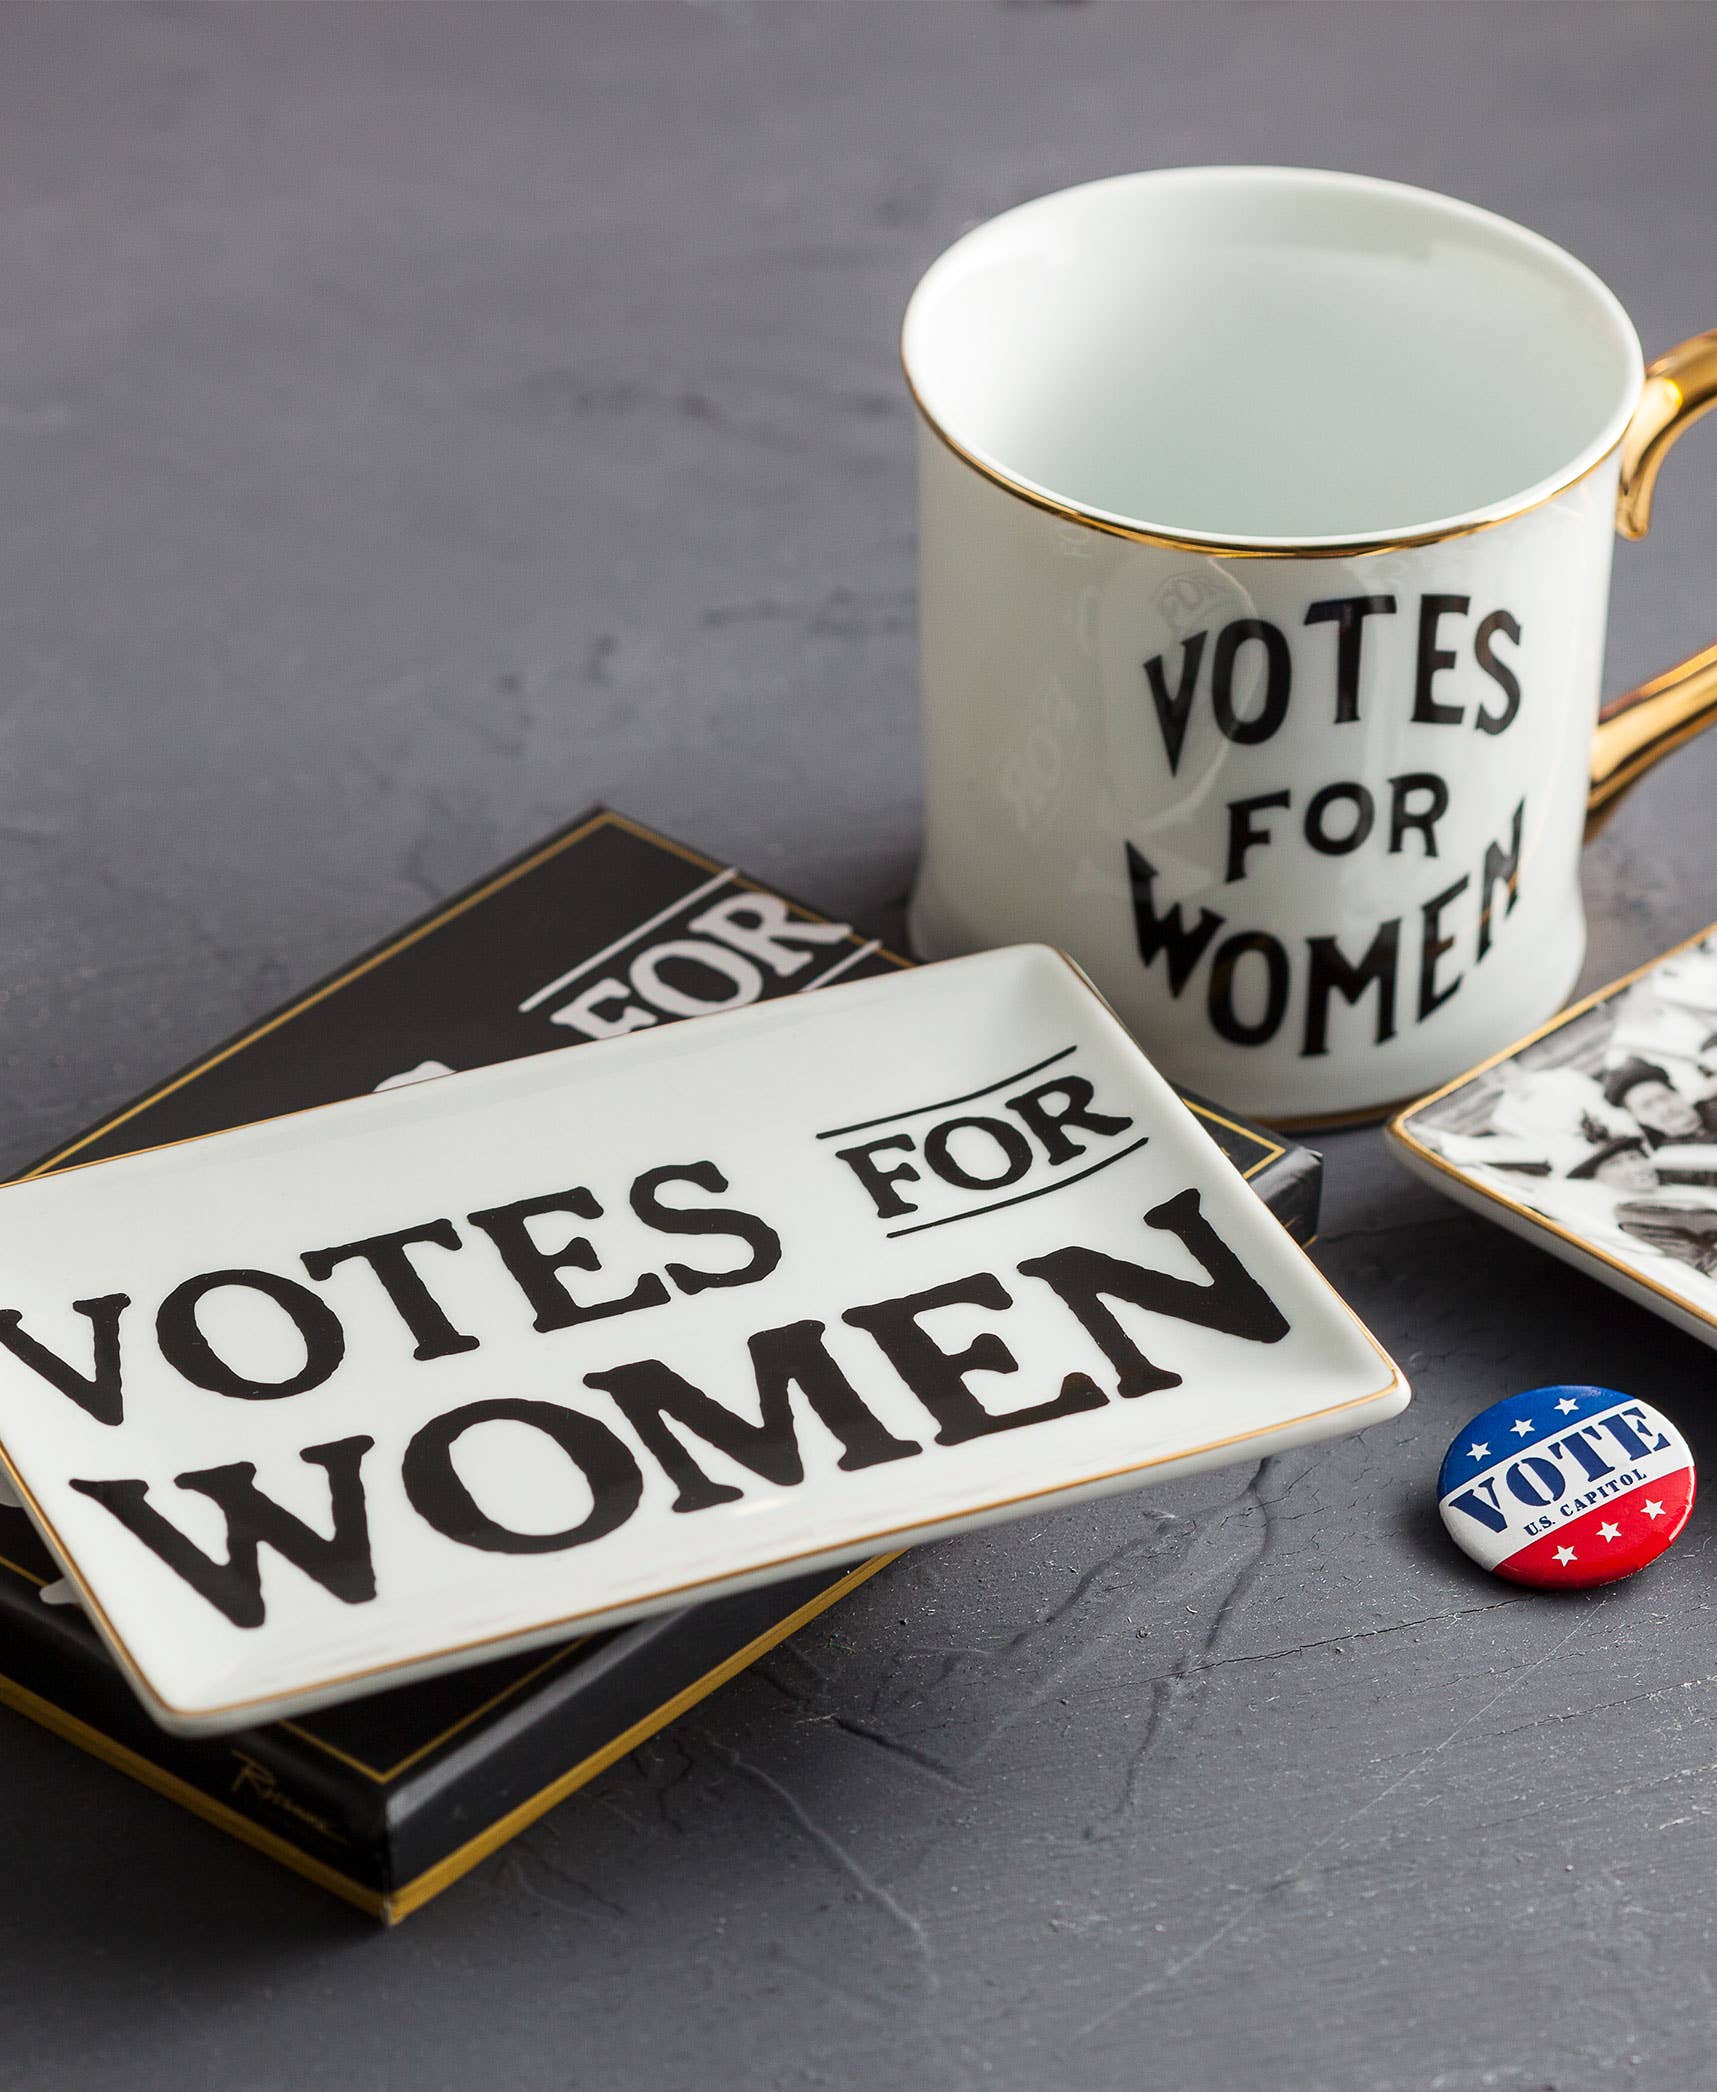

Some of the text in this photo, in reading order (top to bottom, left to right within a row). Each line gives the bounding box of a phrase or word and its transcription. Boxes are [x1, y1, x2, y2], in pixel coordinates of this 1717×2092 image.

[1142, 594, 1521, 779] VOTES
[1225, 773, 1449, 883] FOR
[550, 892, 853, 1041] FOR
[1125, 799, 1524, 1056] WOMEN
[0, 1076, 1133, 1426] VOTES FOR
[69, 1187, 1292, 1628] WOMEN
[1448, 1406, 1671, 1534] VOTE
[1523, 1468, 1648, 1537] U.S. CAPITOL
